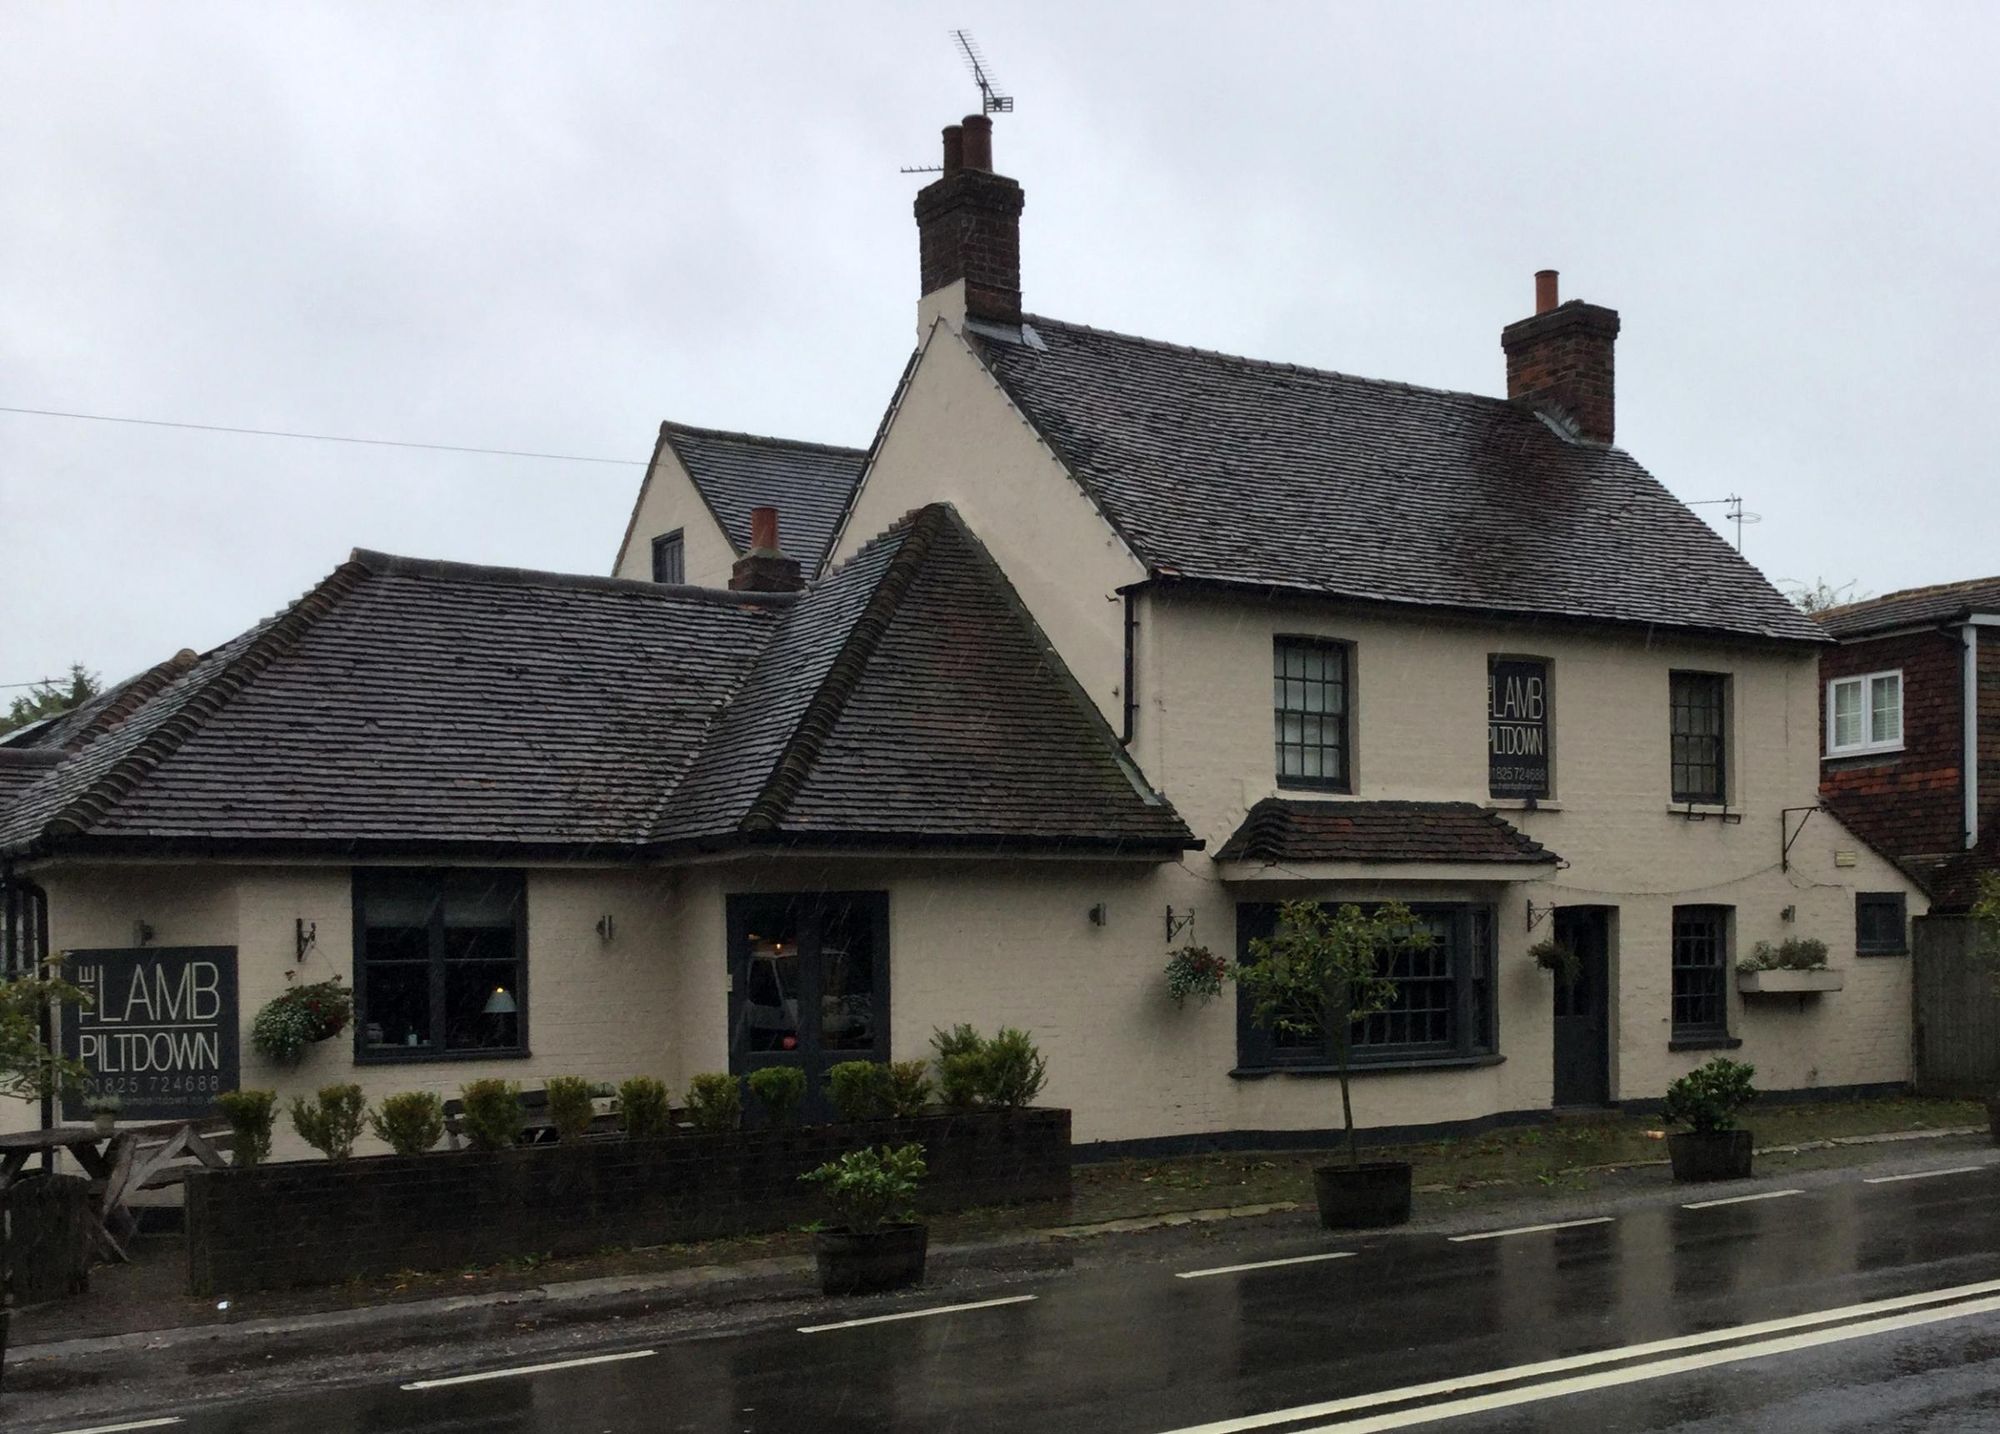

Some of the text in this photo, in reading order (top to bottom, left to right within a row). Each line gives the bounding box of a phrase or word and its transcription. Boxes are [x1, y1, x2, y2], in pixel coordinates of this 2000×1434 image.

[1493, 675, 1543, 719] LAMB
[1489, 766, 1513, 780] 1825
[99, 962, 220, 1022] LAMB
[80, 1032, 218, 1072] PILTDOWN
[149, 1076, 220, 1092] 724688
